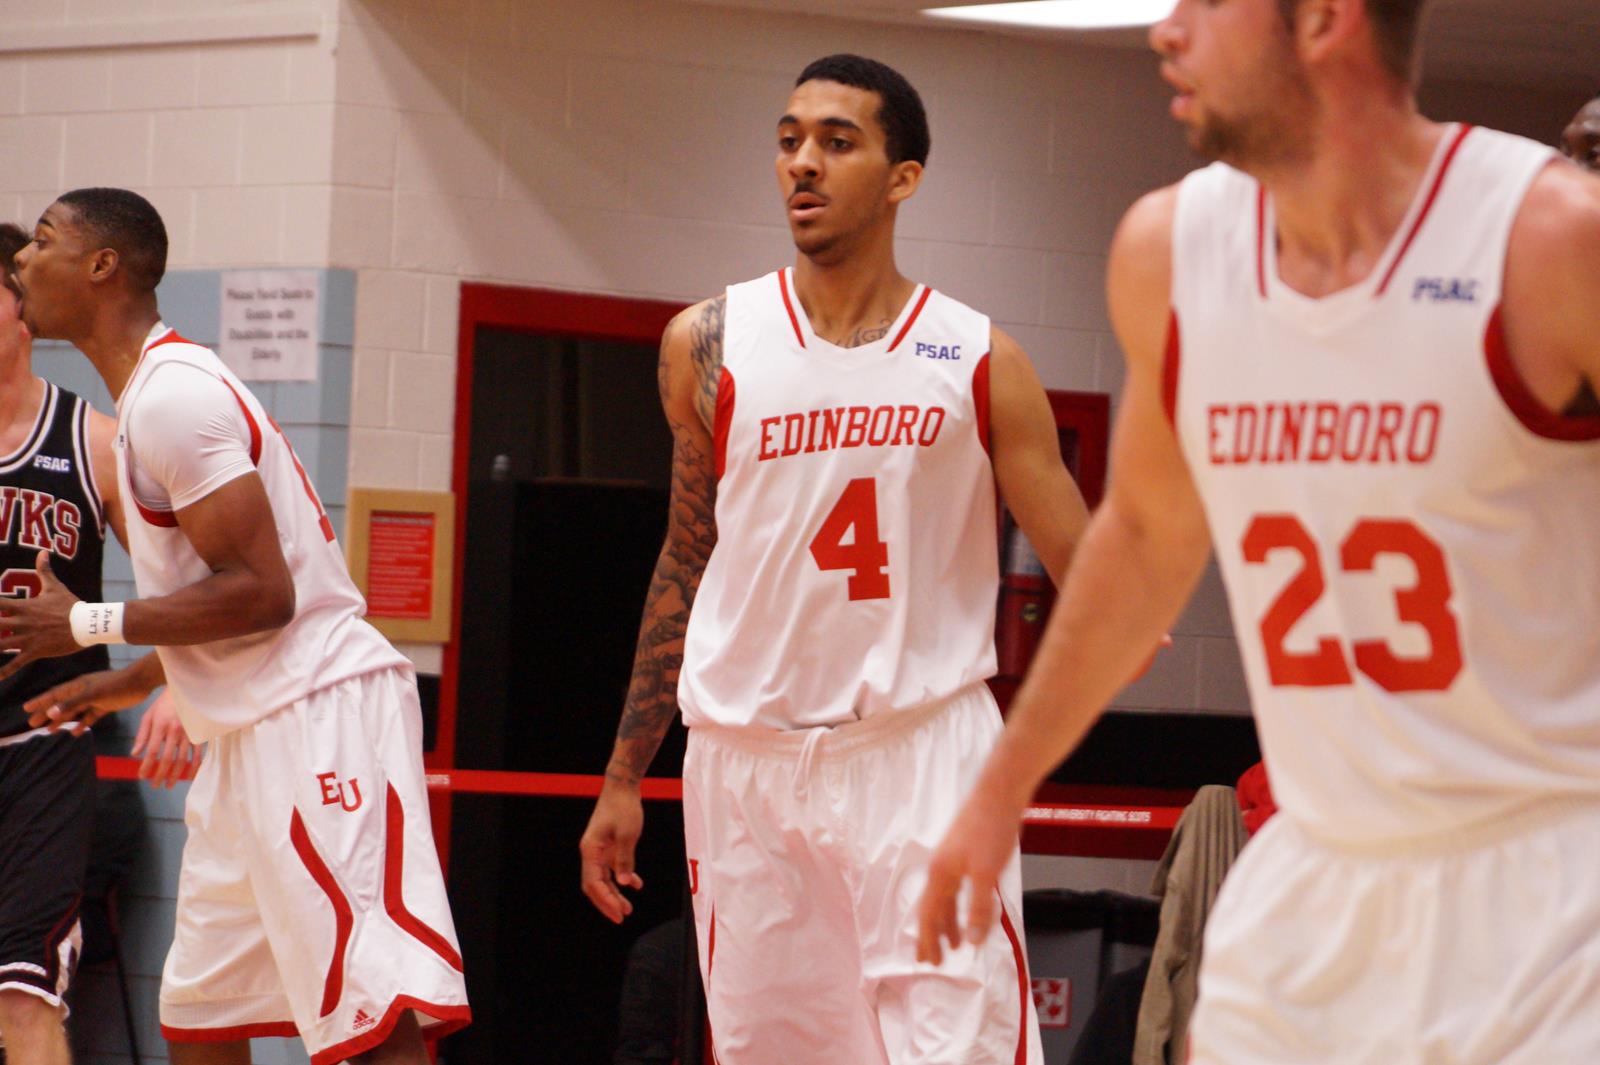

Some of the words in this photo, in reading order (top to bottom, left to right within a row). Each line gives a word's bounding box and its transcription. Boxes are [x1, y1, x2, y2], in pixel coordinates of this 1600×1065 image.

[1412, 278, 1480, 302] PSAC
[916, 342, 961, 360] PSAC
[758, 405, 945, 461] EDINBORO
[1207, 401, 1442, 466] EDINBORO
[33, 455, 70, 472] PSAC
[809, 477, 890, 601] 4
[1241, 513, 1464, 693] 23
[316, 771, 363, 812] EU
